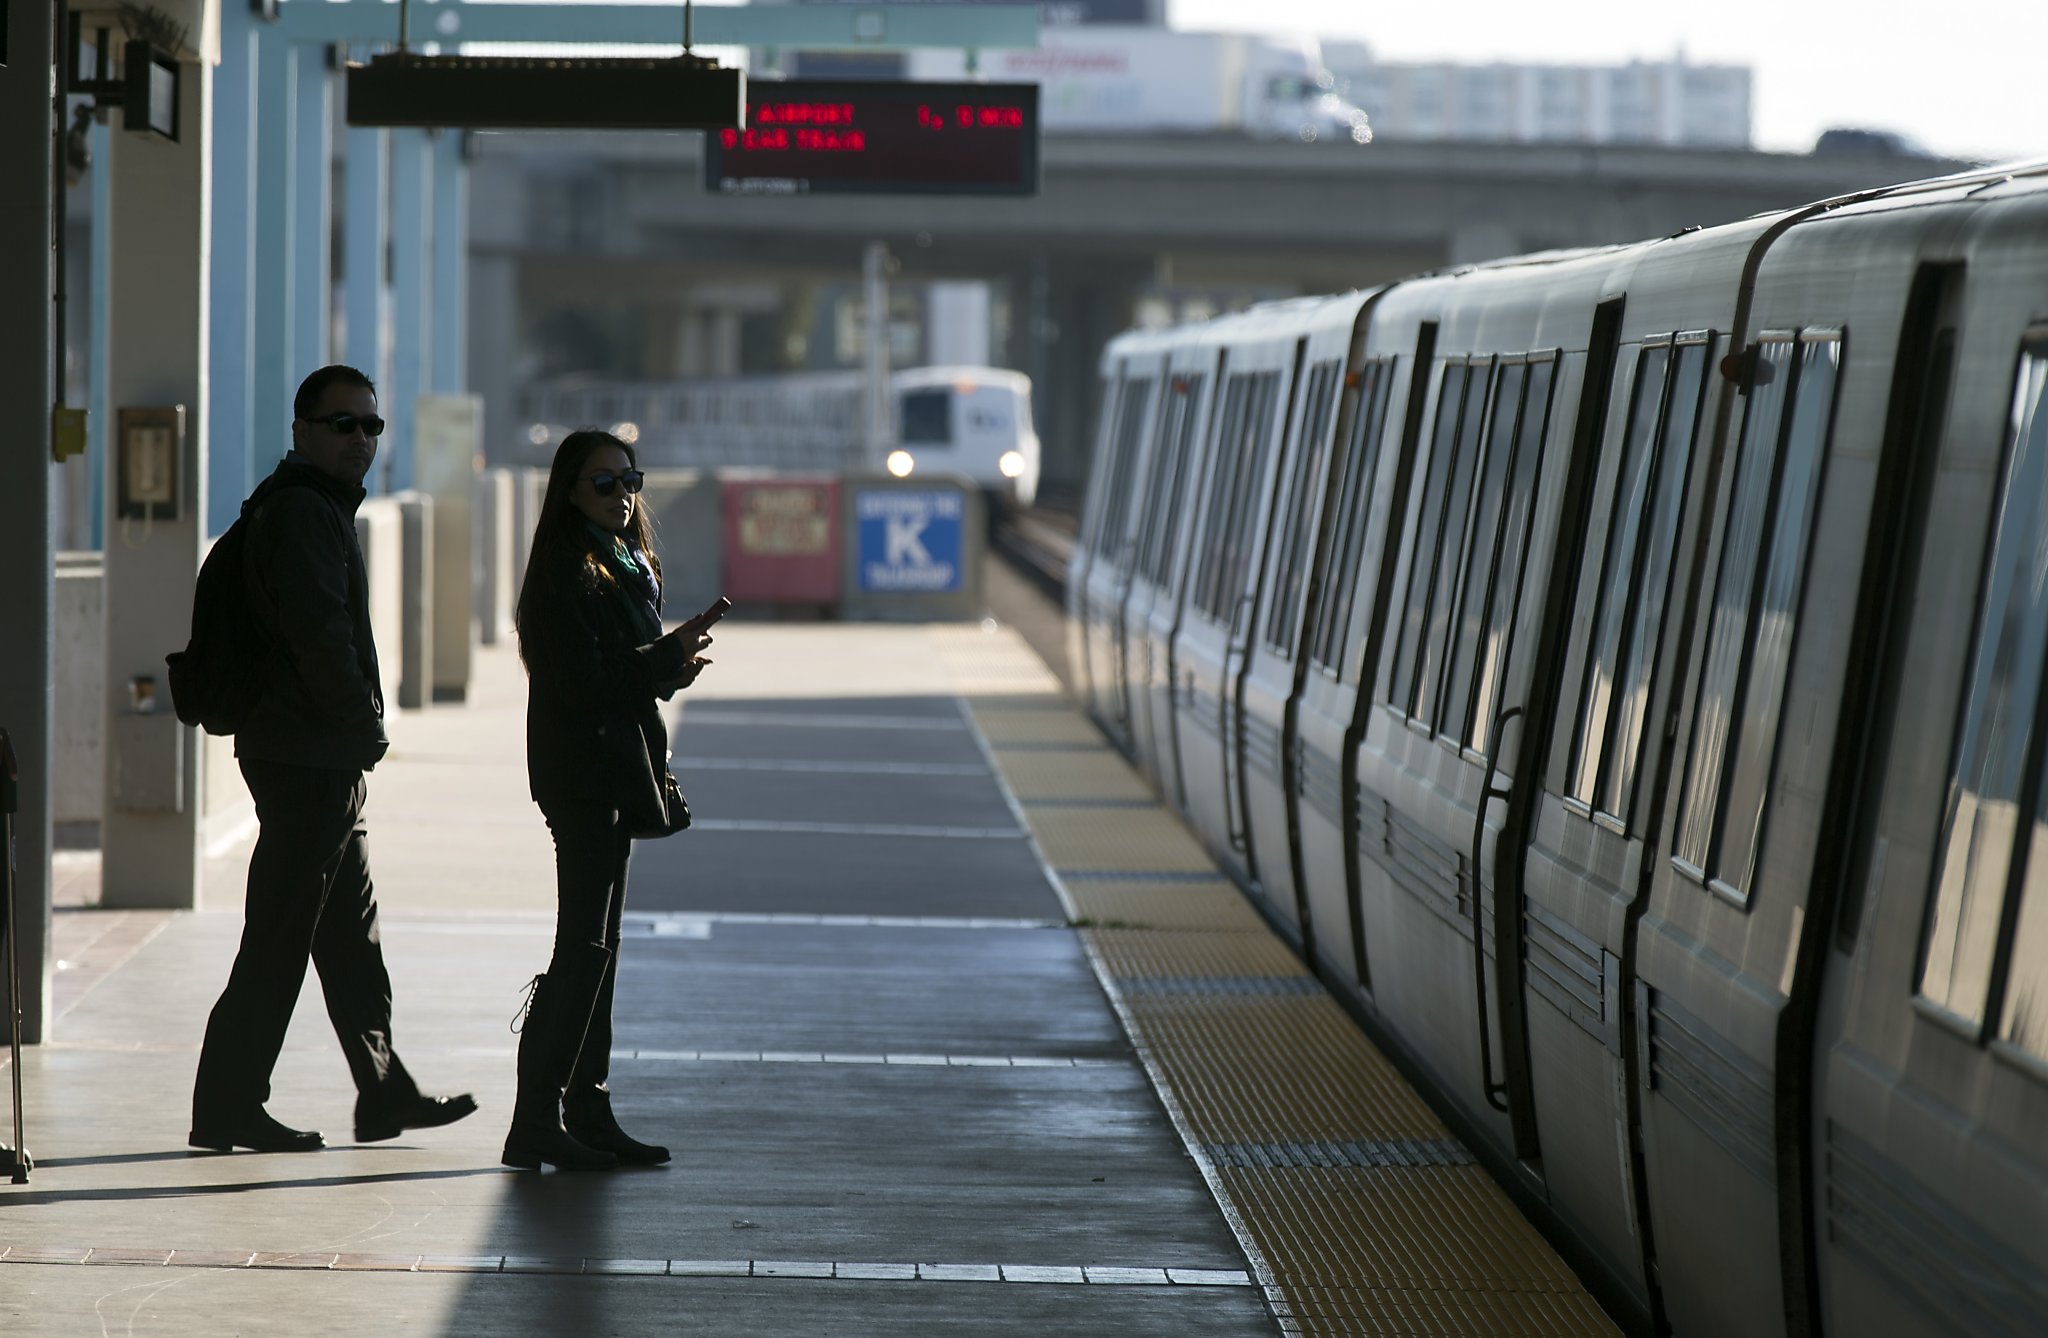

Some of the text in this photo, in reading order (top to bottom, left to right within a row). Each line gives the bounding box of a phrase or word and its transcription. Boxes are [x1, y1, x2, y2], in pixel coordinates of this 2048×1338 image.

[757, 104, 854, 124] AIRPORT
[979, 106, 1022, 127] MIN
[742, 128, 788, 149] CAR
[796, 129, 865, 150] TRAIN
[884, 513, 933, 566] K
